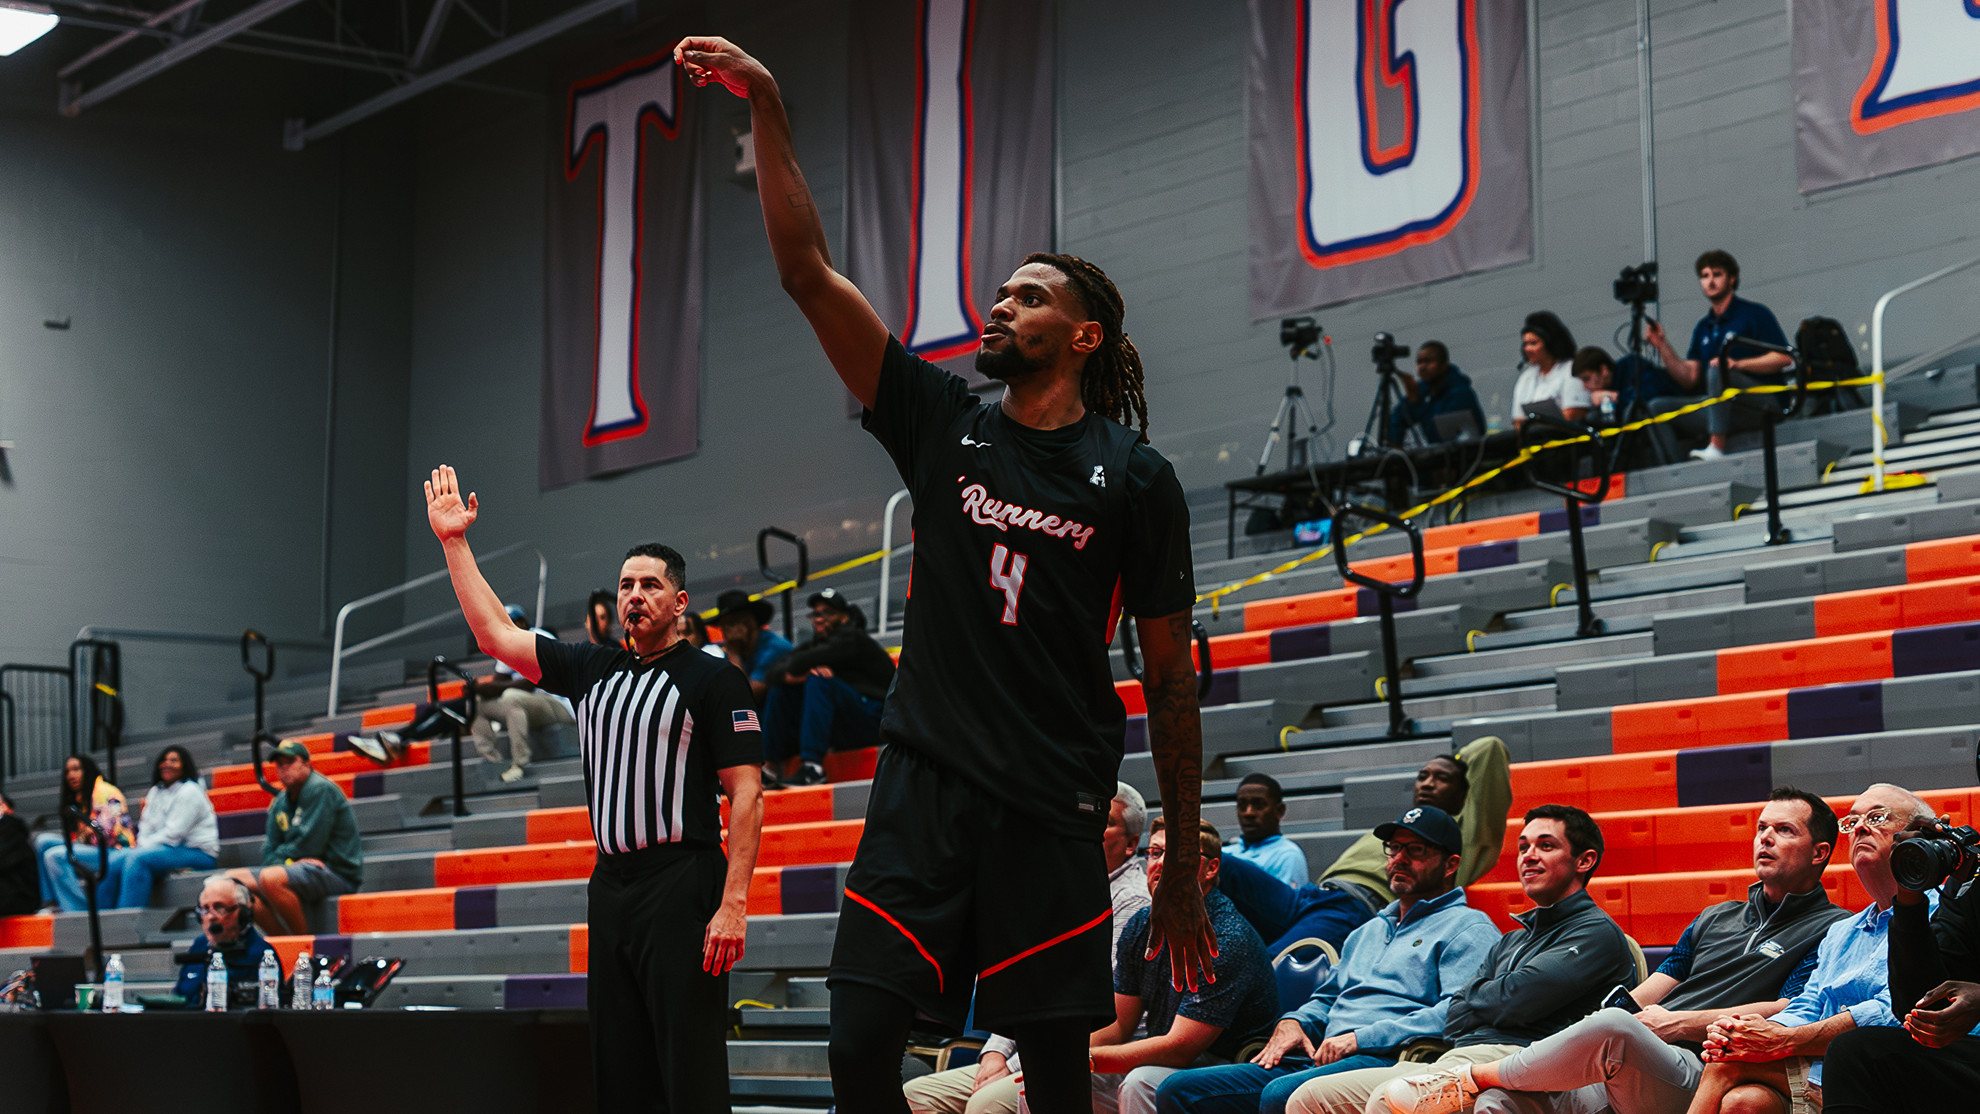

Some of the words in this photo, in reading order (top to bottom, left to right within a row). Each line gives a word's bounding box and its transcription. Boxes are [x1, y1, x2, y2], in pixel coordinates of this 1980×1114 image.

[565, 40, 684, 447] T
[1295, 0, 1480, 270] G
[989, 542, 1029, 626] 4
